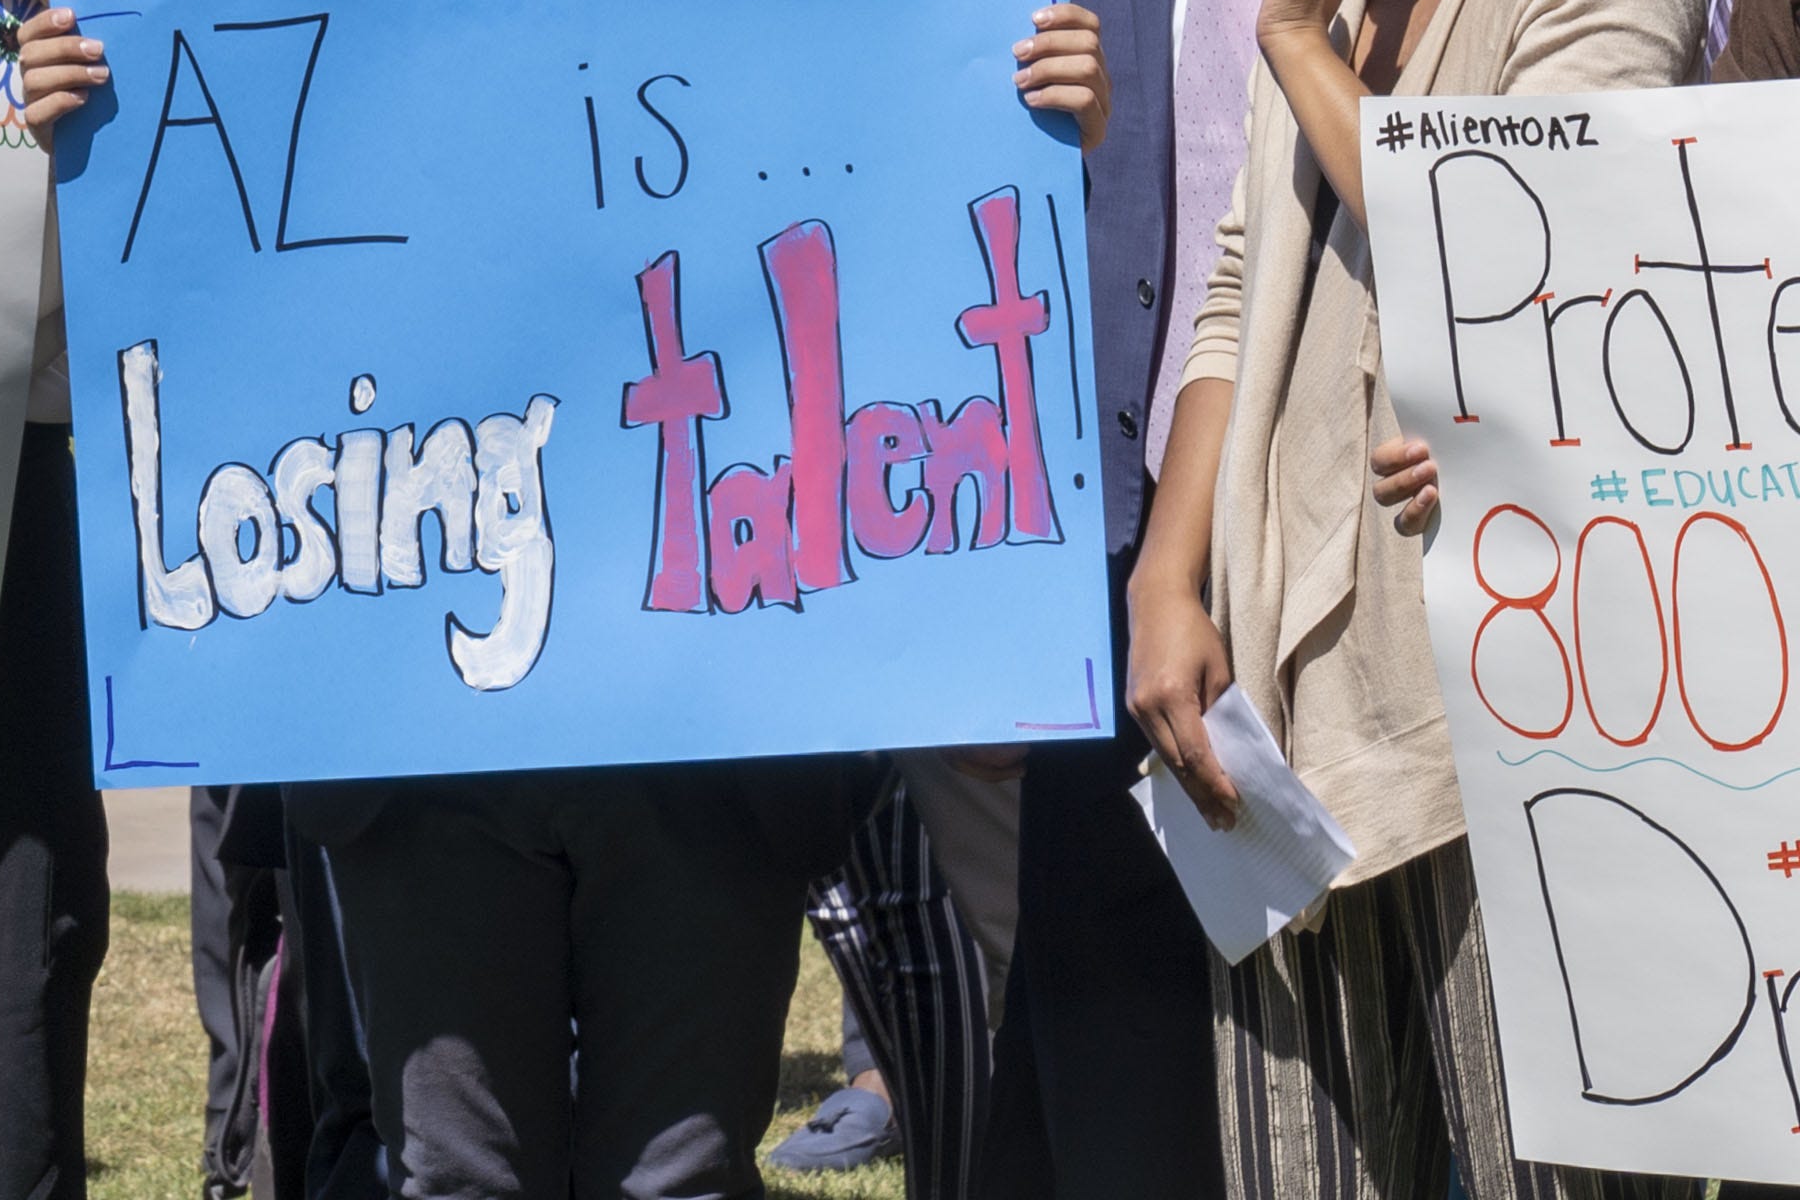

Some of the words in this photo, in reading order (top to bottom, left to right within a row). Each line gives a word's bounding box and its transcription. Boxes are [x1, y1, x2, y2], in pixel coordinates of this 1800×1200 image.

[120, 12, 409, 264] AZ
[117, 338, 561, 692] Losing
[1471, 502, 1789, 753] 800
